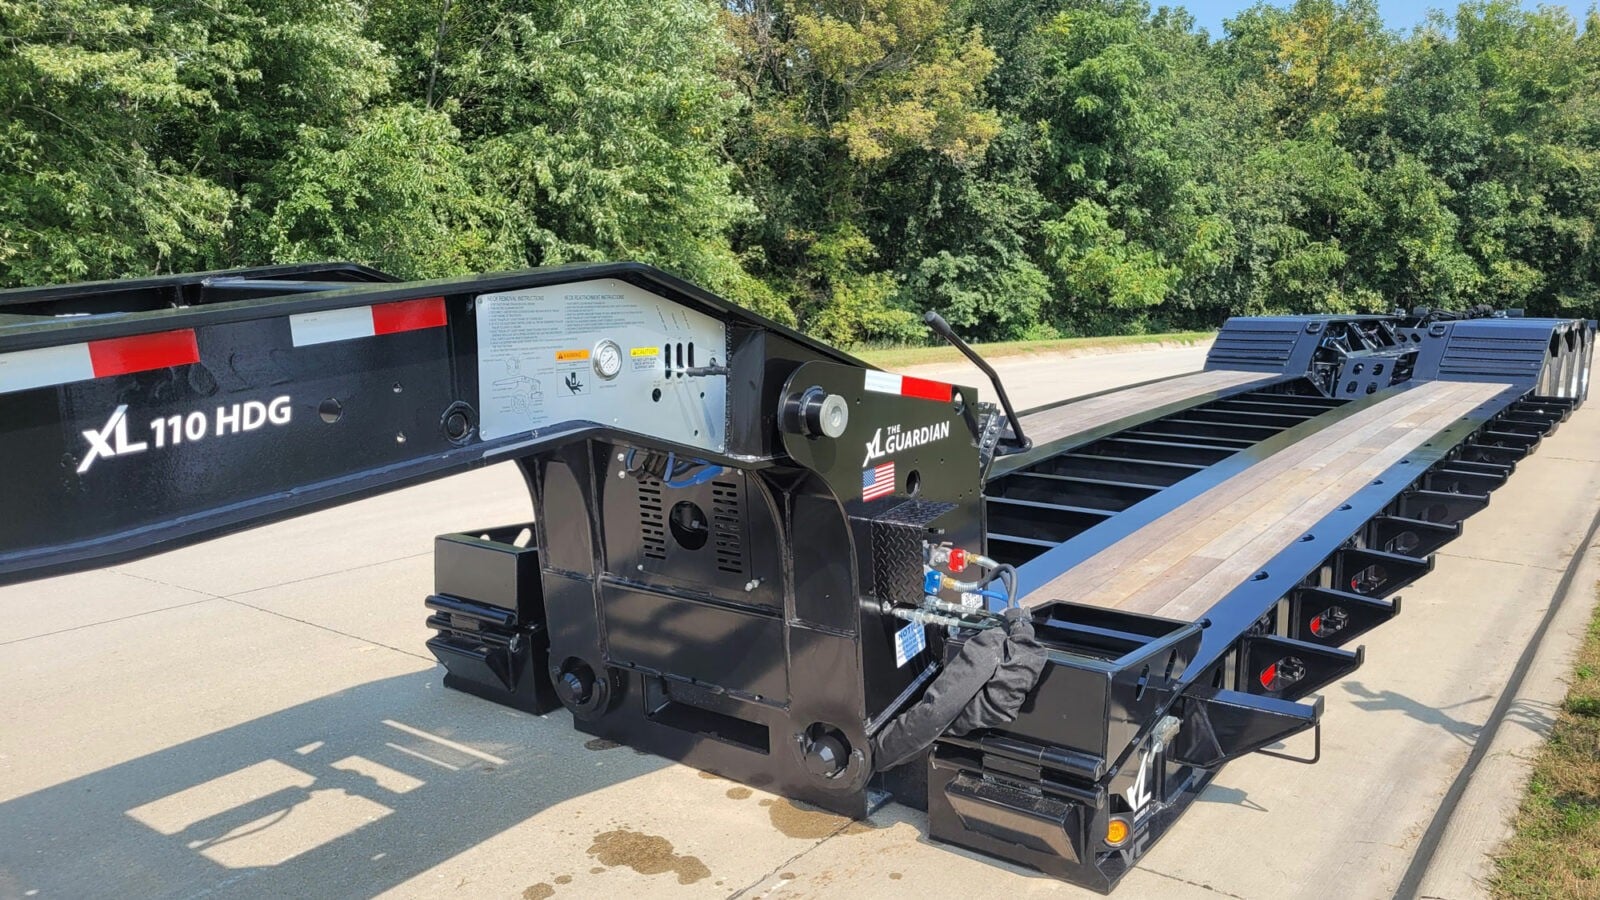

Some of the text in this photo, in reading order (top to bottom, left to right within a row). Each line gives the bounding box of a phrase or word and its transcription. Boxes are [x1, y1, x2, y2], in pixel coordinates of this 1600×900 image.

[76, 395, 292, 473] XL 110 HDG
[862, 420, 950, 468] XL GUARDIAN
[887, 424, 901, 436] THE
